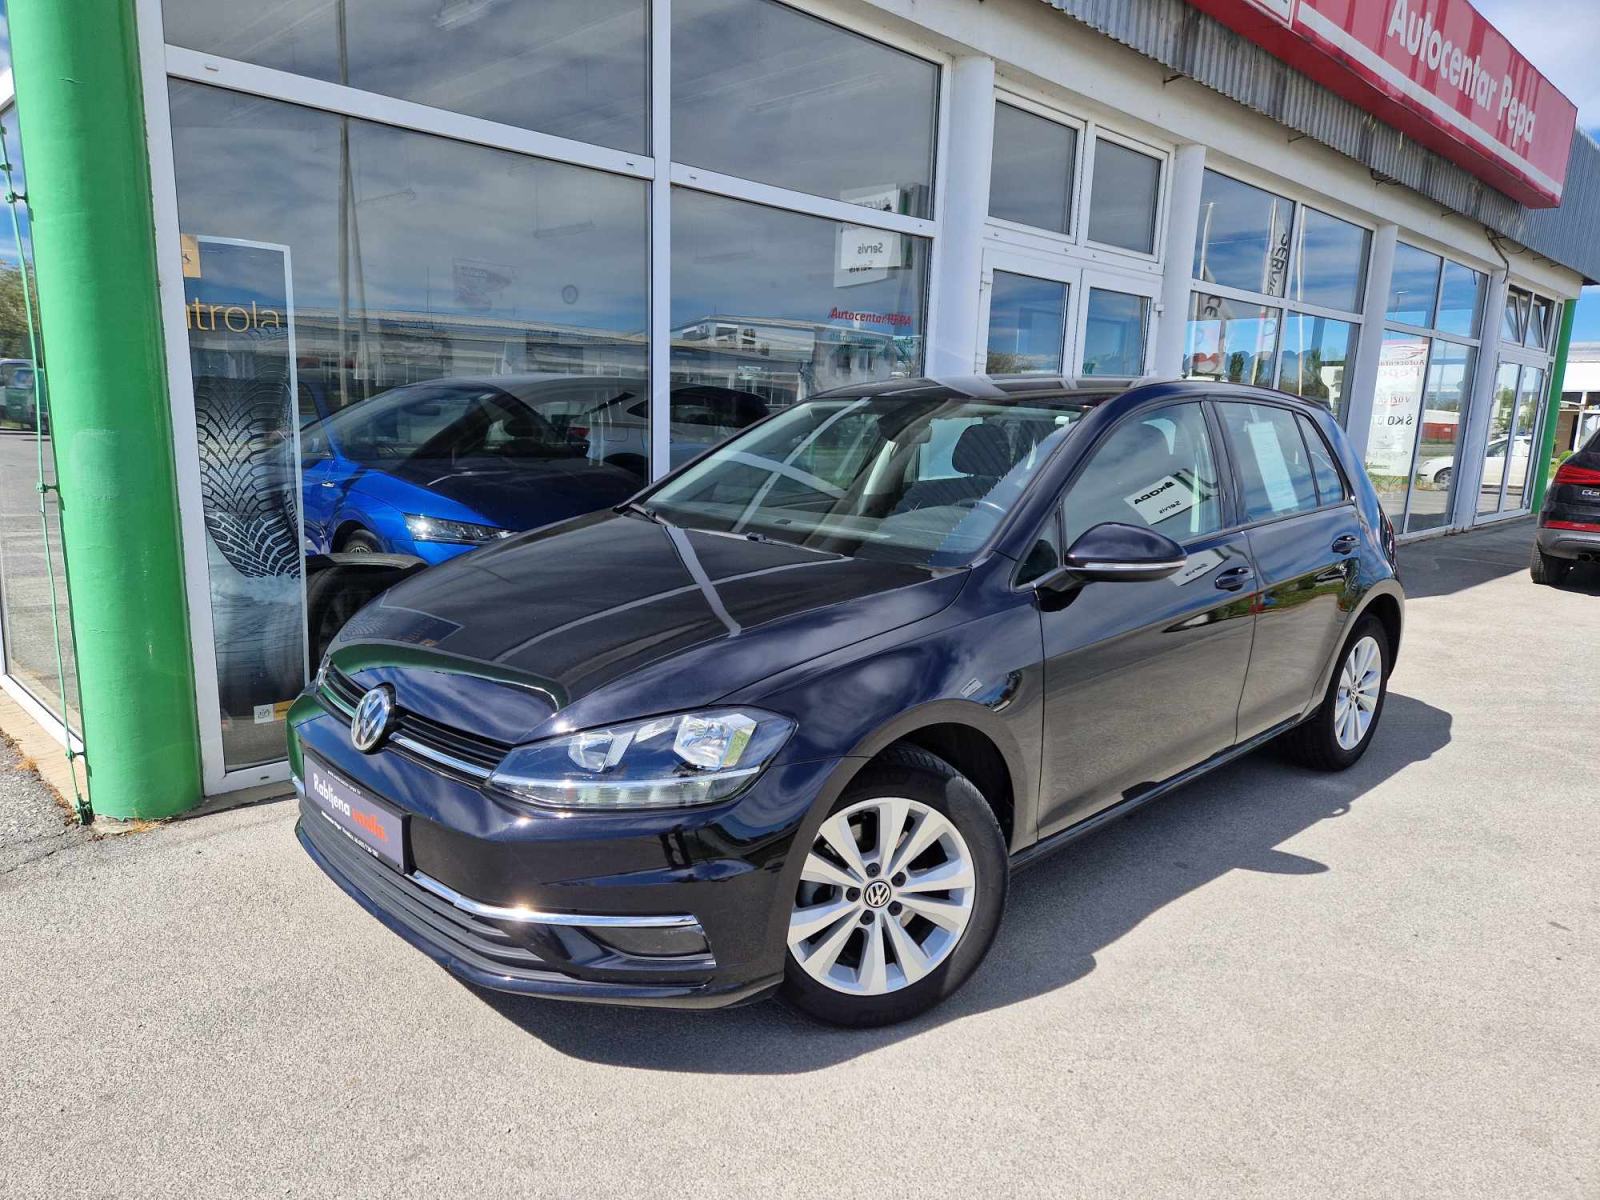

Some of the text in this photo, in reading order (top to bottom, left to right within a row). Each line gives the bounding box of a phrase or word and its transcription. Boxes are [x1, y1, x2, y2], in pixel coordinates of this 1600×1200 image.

[1387, 0, 1537, 148] Autocentar Pepa
[312, 772, 351, 817] Rabljena
